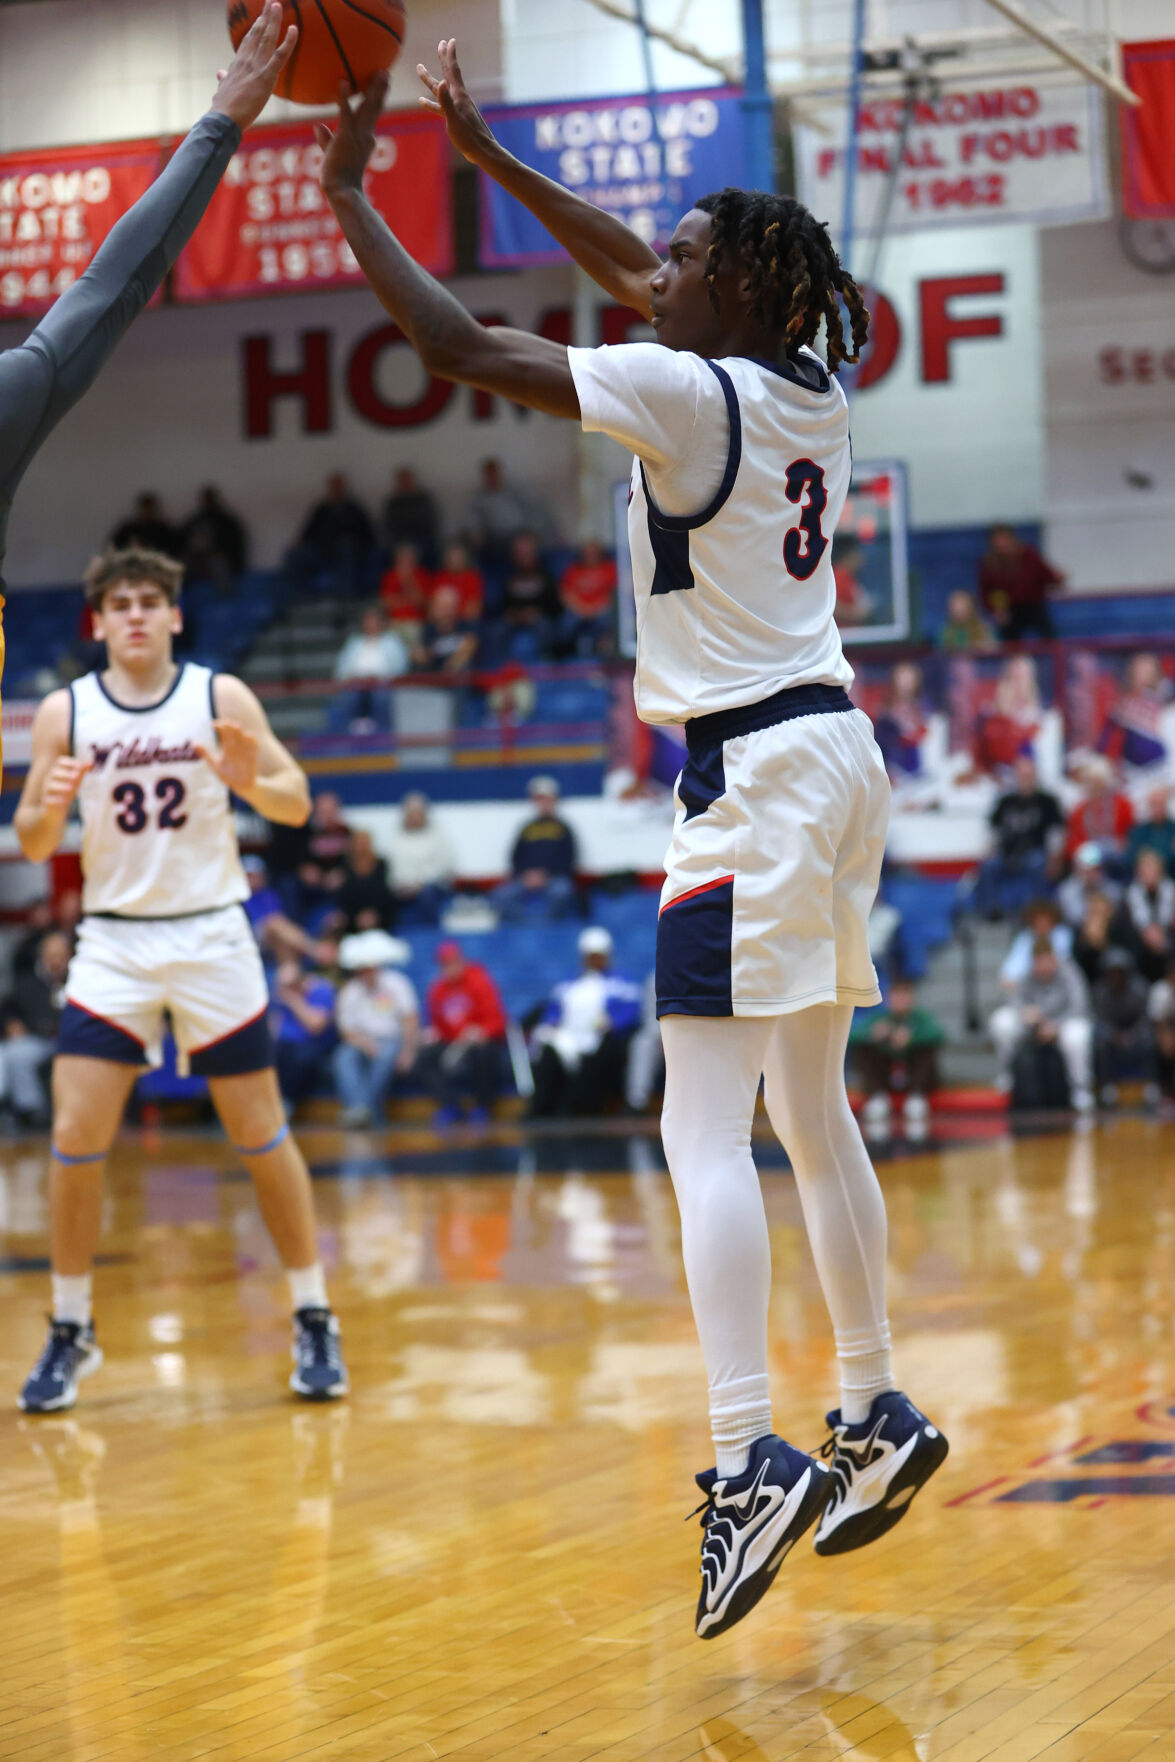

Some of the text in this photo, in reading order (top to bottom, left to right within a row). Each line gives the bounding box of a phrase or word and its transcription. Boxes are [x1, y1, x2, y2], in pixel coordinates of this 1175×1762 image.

[535, 98, 719, 149] KOKOMO
[960, 123, 1080, 164] FOUR
[223, 134, 397, 187] KOKOO
[558, 138, 694, 186] STATE
[905, 172, 1006, 211] 1962
[783, 458, 829, 581] 3
[112, 776, 187, 835] 32
